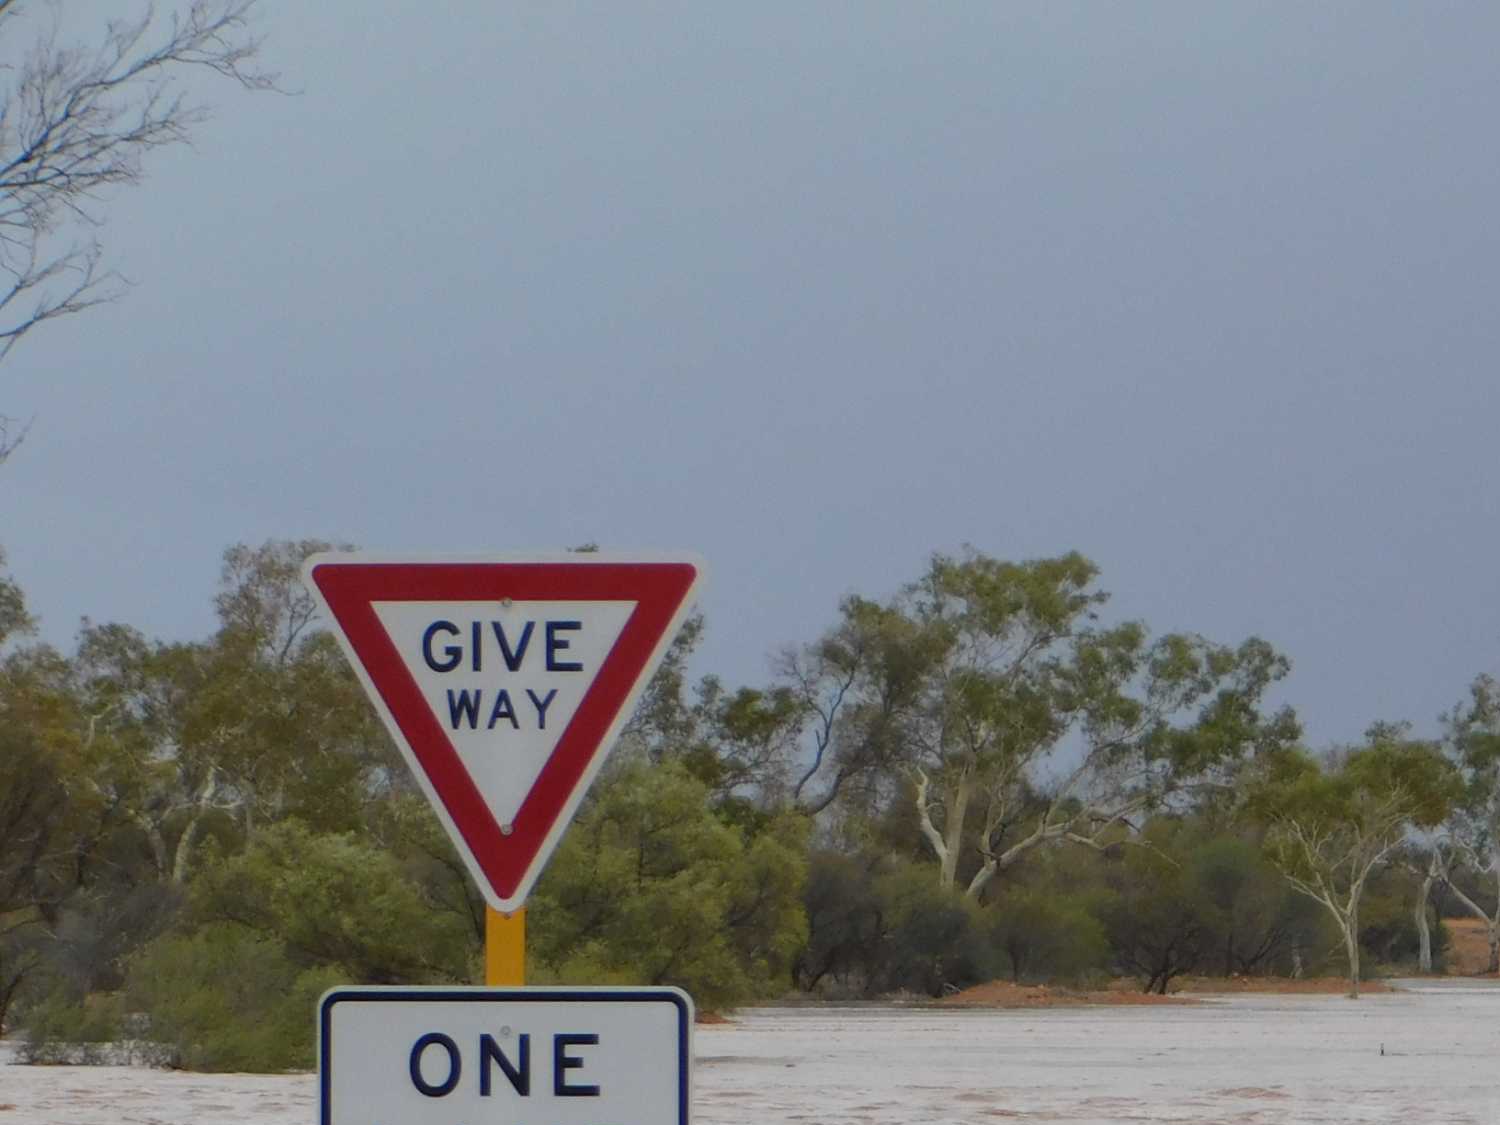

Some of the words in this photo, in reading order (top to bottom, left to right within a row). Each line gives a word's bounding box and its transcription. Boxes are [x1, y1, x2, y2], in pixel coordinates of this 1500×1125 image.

[422, 620, 584, 673] GIVE
[446, 688, 558, 730] WAY
[409, 1032, 601, 1098] ONE
